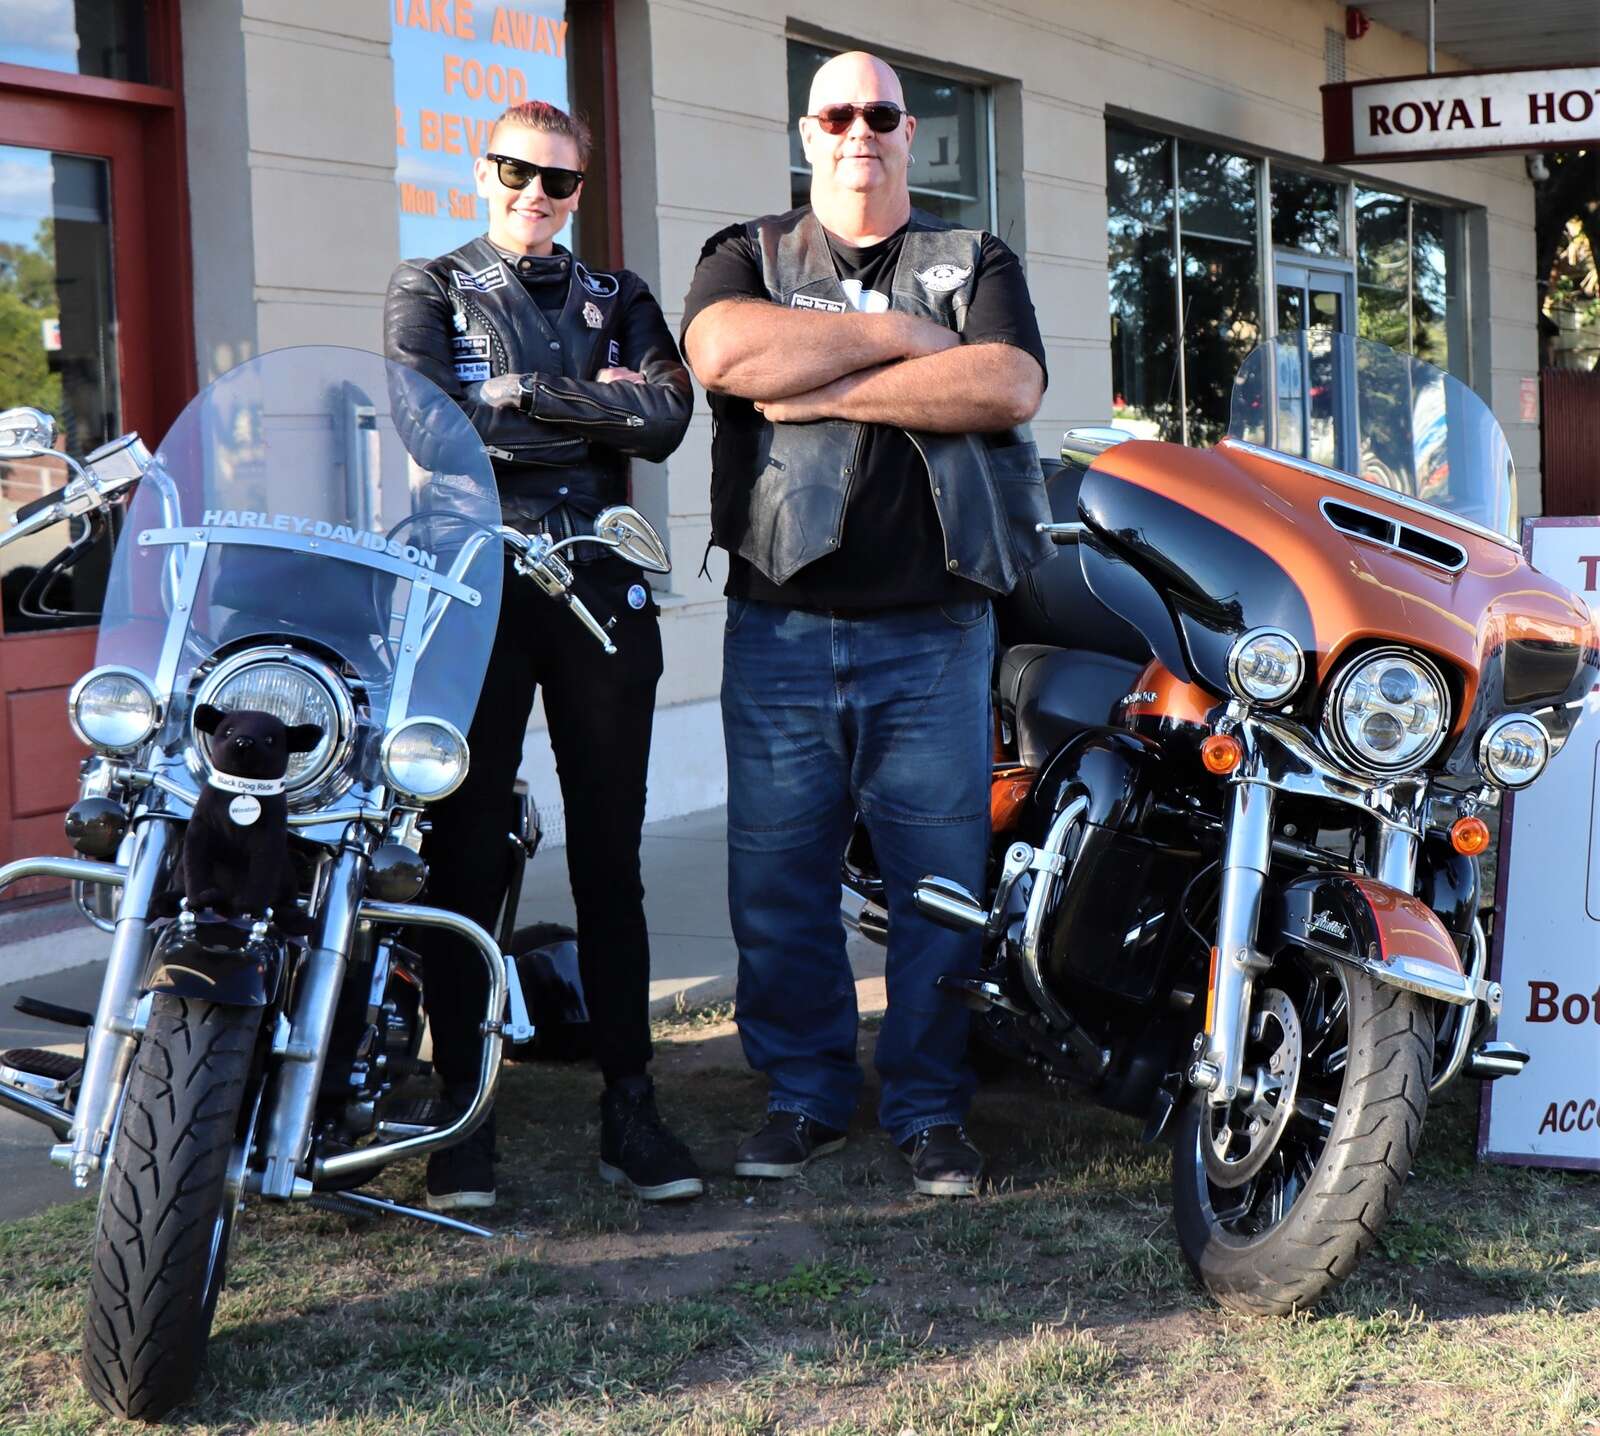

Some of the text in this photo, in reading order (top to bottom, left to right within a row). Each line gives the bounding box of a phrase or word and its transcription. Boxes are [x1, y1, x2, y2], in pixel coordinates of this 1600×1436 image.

[491, 7, 568, 58] AWAY
[443, 54, 527, 106] FOOD
[1369, 89, 1600, 136] ROYAL HO
[401, 183, 437, 217] Mon
[447, 188, 477, 220] Sat
[203, 510, 438, 570] HARLEY-DAVIDSON
[238, 781, 256, 791] Dog
[257, 782, 273, 791] Ride
[1538, 1099, 1600, 1135] ACC
